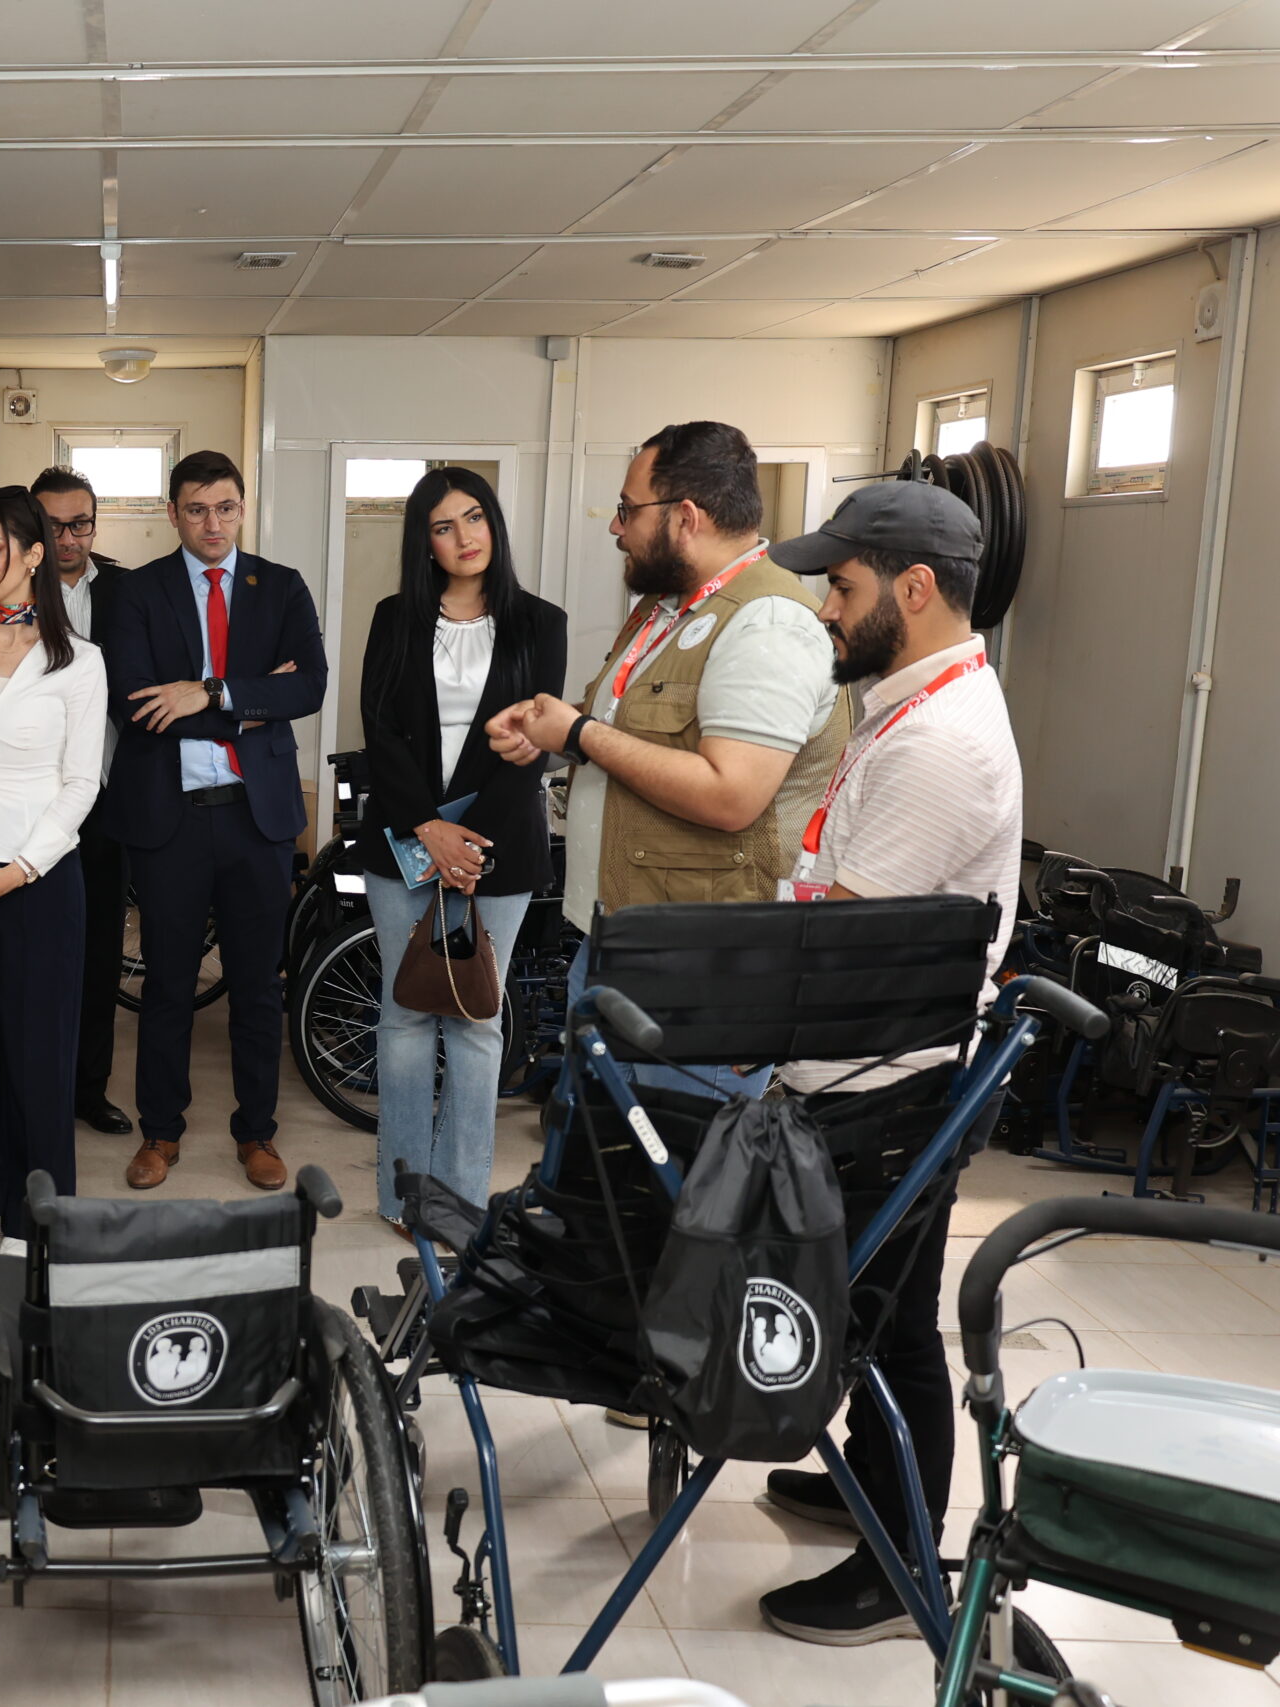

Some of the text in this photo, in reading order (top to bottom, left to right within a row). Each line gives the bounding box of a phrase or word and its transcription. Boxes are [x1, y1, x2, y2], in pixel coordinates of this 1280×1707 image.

[748, 1284, 803, 1315] CHARITIES
[142, 1316, 217, 1340] LDS CHARITIES
